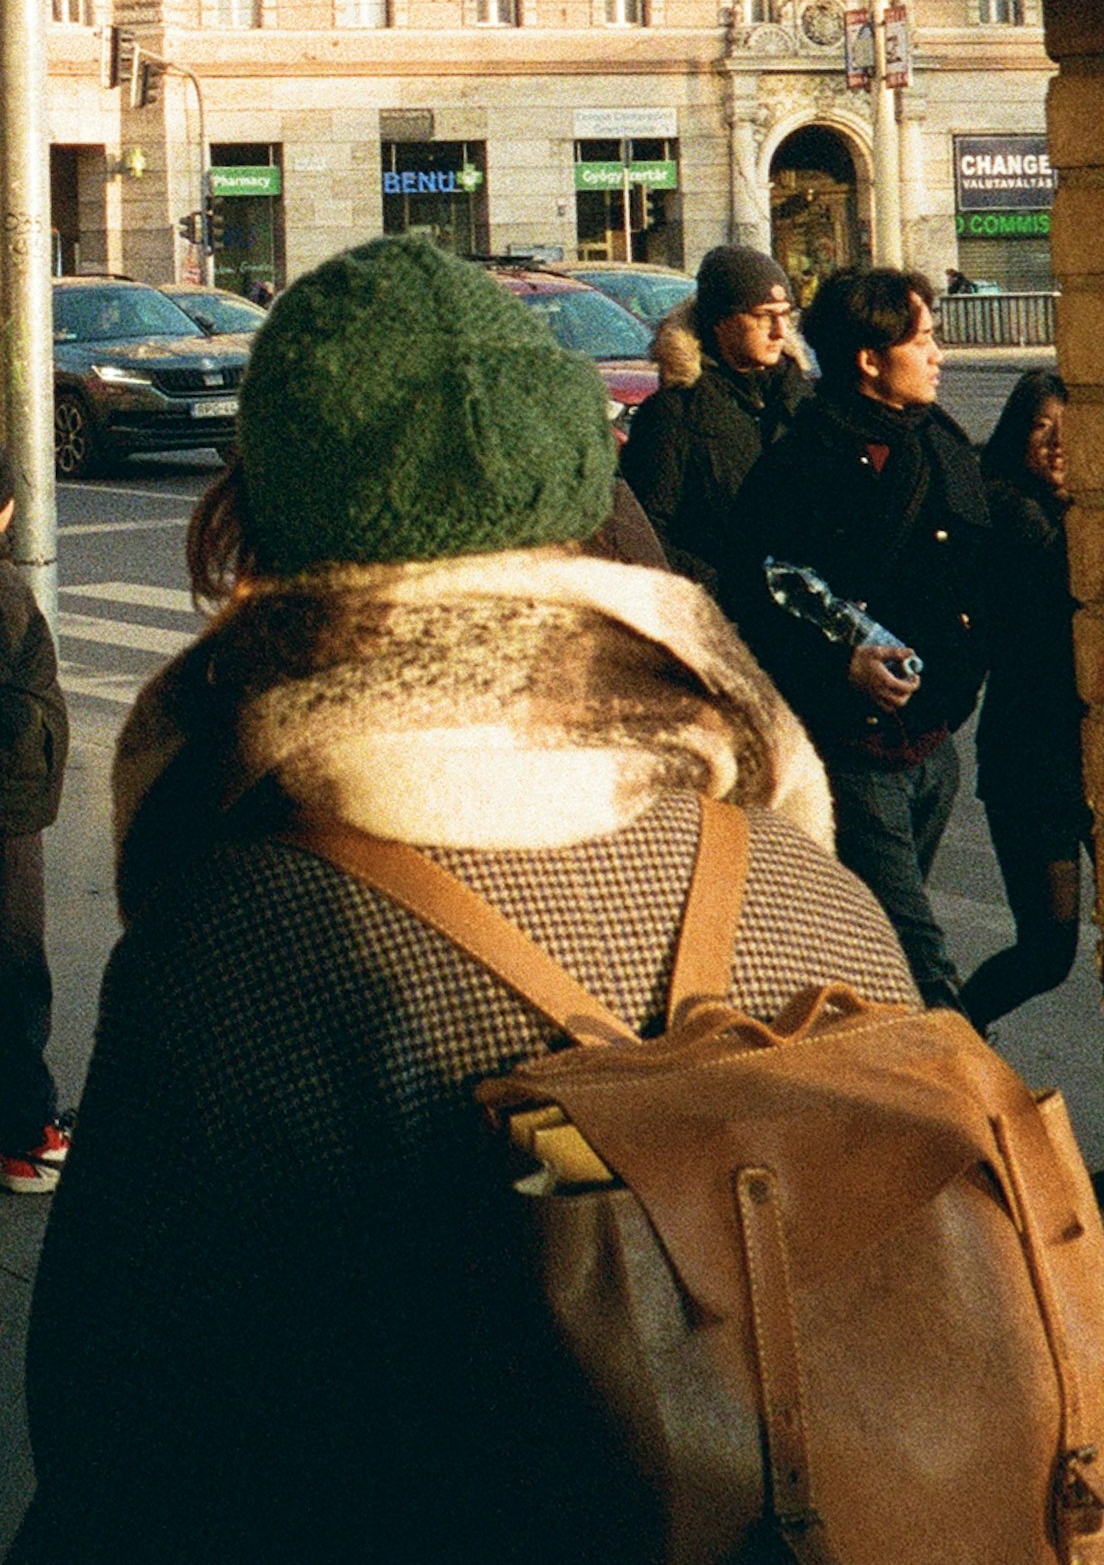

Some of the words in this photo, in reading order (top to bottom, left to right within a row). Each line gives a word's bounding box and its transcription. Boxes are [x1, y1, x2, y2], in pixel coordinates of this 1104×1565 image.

[961, 154, 1053, 176] CHANGE
[211, 174, 271, 189] Pharmacy
[383, 170, 455, 193] BENU
[582, 168, 669, 185] Gyógyzertár
[962, 177, 1054, 189] VALUTAVÁLTÁS
